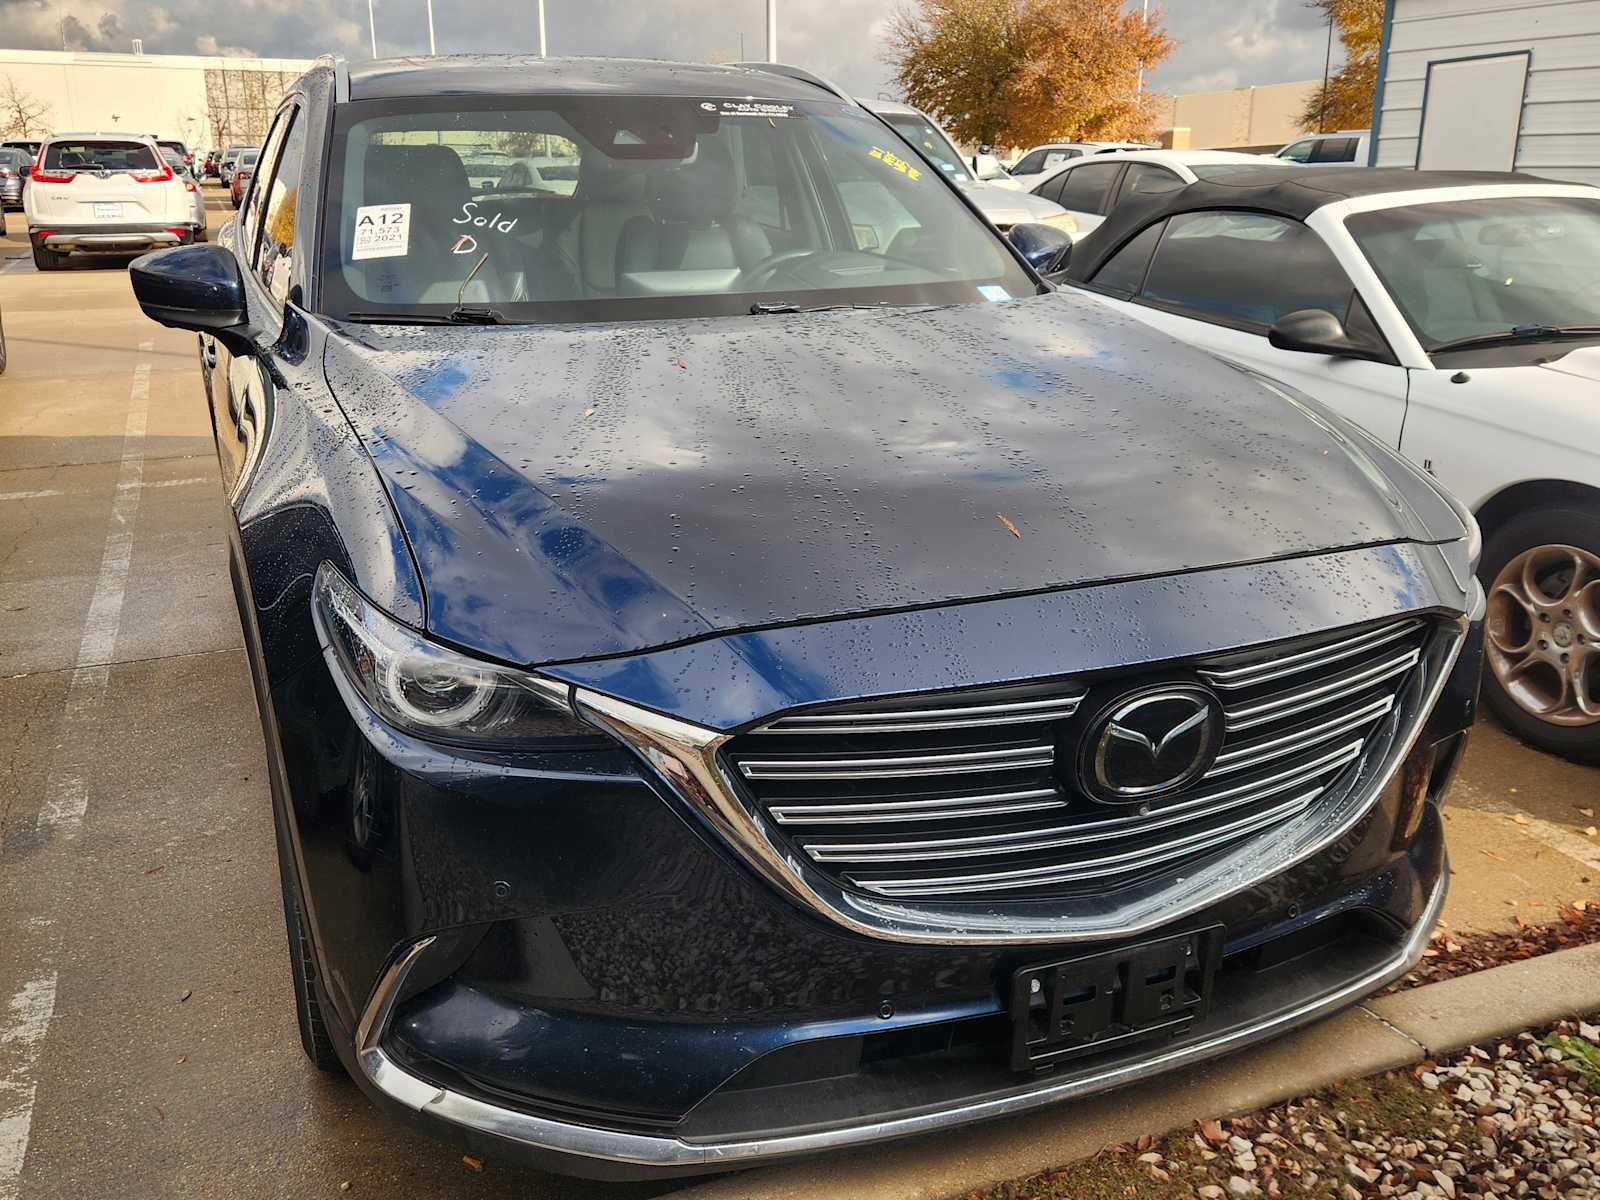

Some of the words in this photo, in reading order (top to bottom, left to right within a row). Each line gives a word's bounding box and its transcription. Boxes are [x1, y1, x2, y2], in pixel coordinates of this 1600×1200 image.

[358, 213, 404, 227] A12
[452, 202, 518, 233] Sold
[374, 234, 402, 242] 2021
